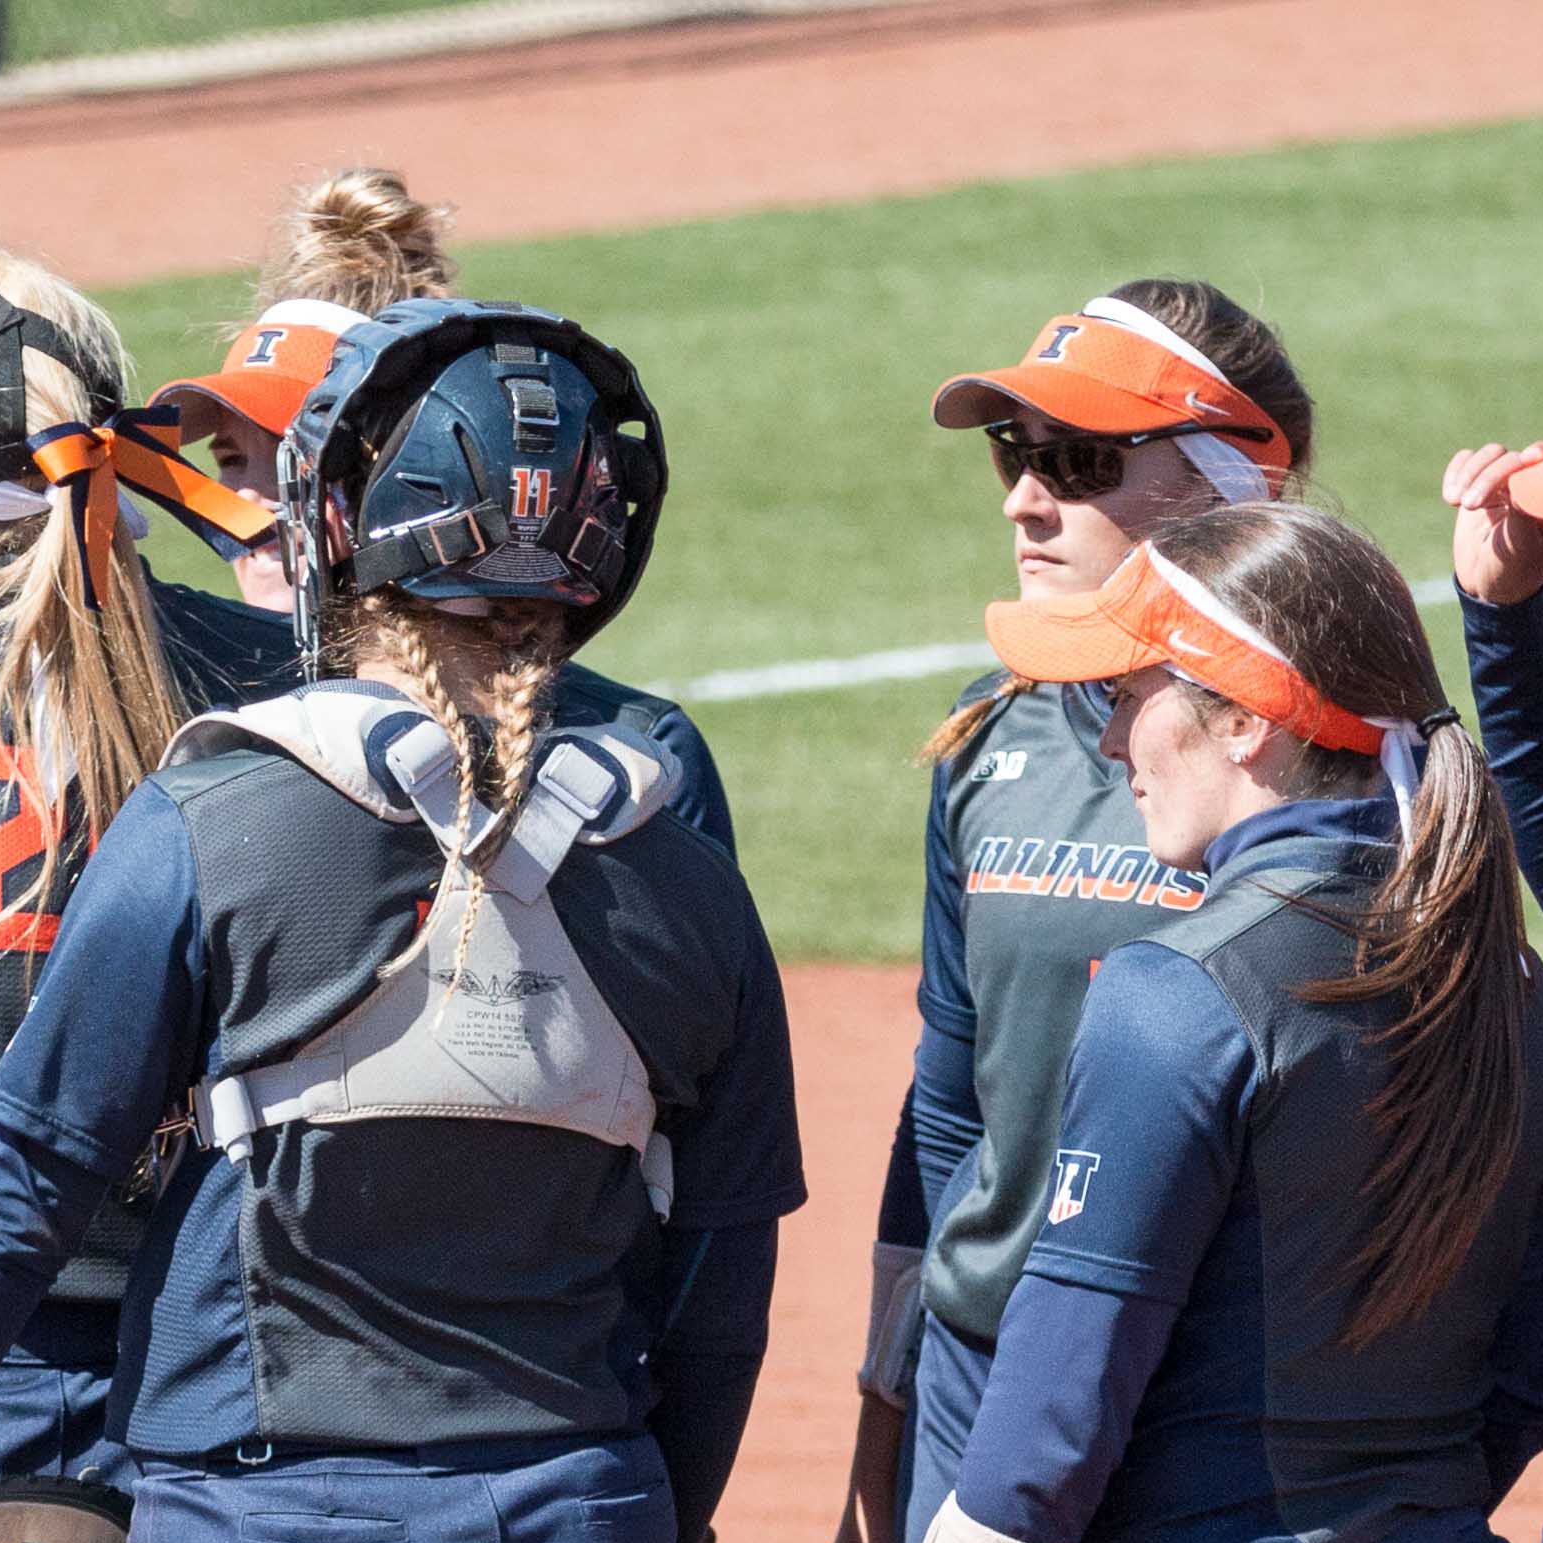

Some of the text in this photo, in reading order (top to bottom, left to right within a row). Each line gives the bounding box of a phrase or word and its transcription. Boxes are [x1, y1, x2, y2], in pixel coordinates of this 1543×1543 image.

[243, 328, 288, 366] I
[1037, 325, 1084, 363] I
[968, 837, 1209, 912] ILLINOIS
